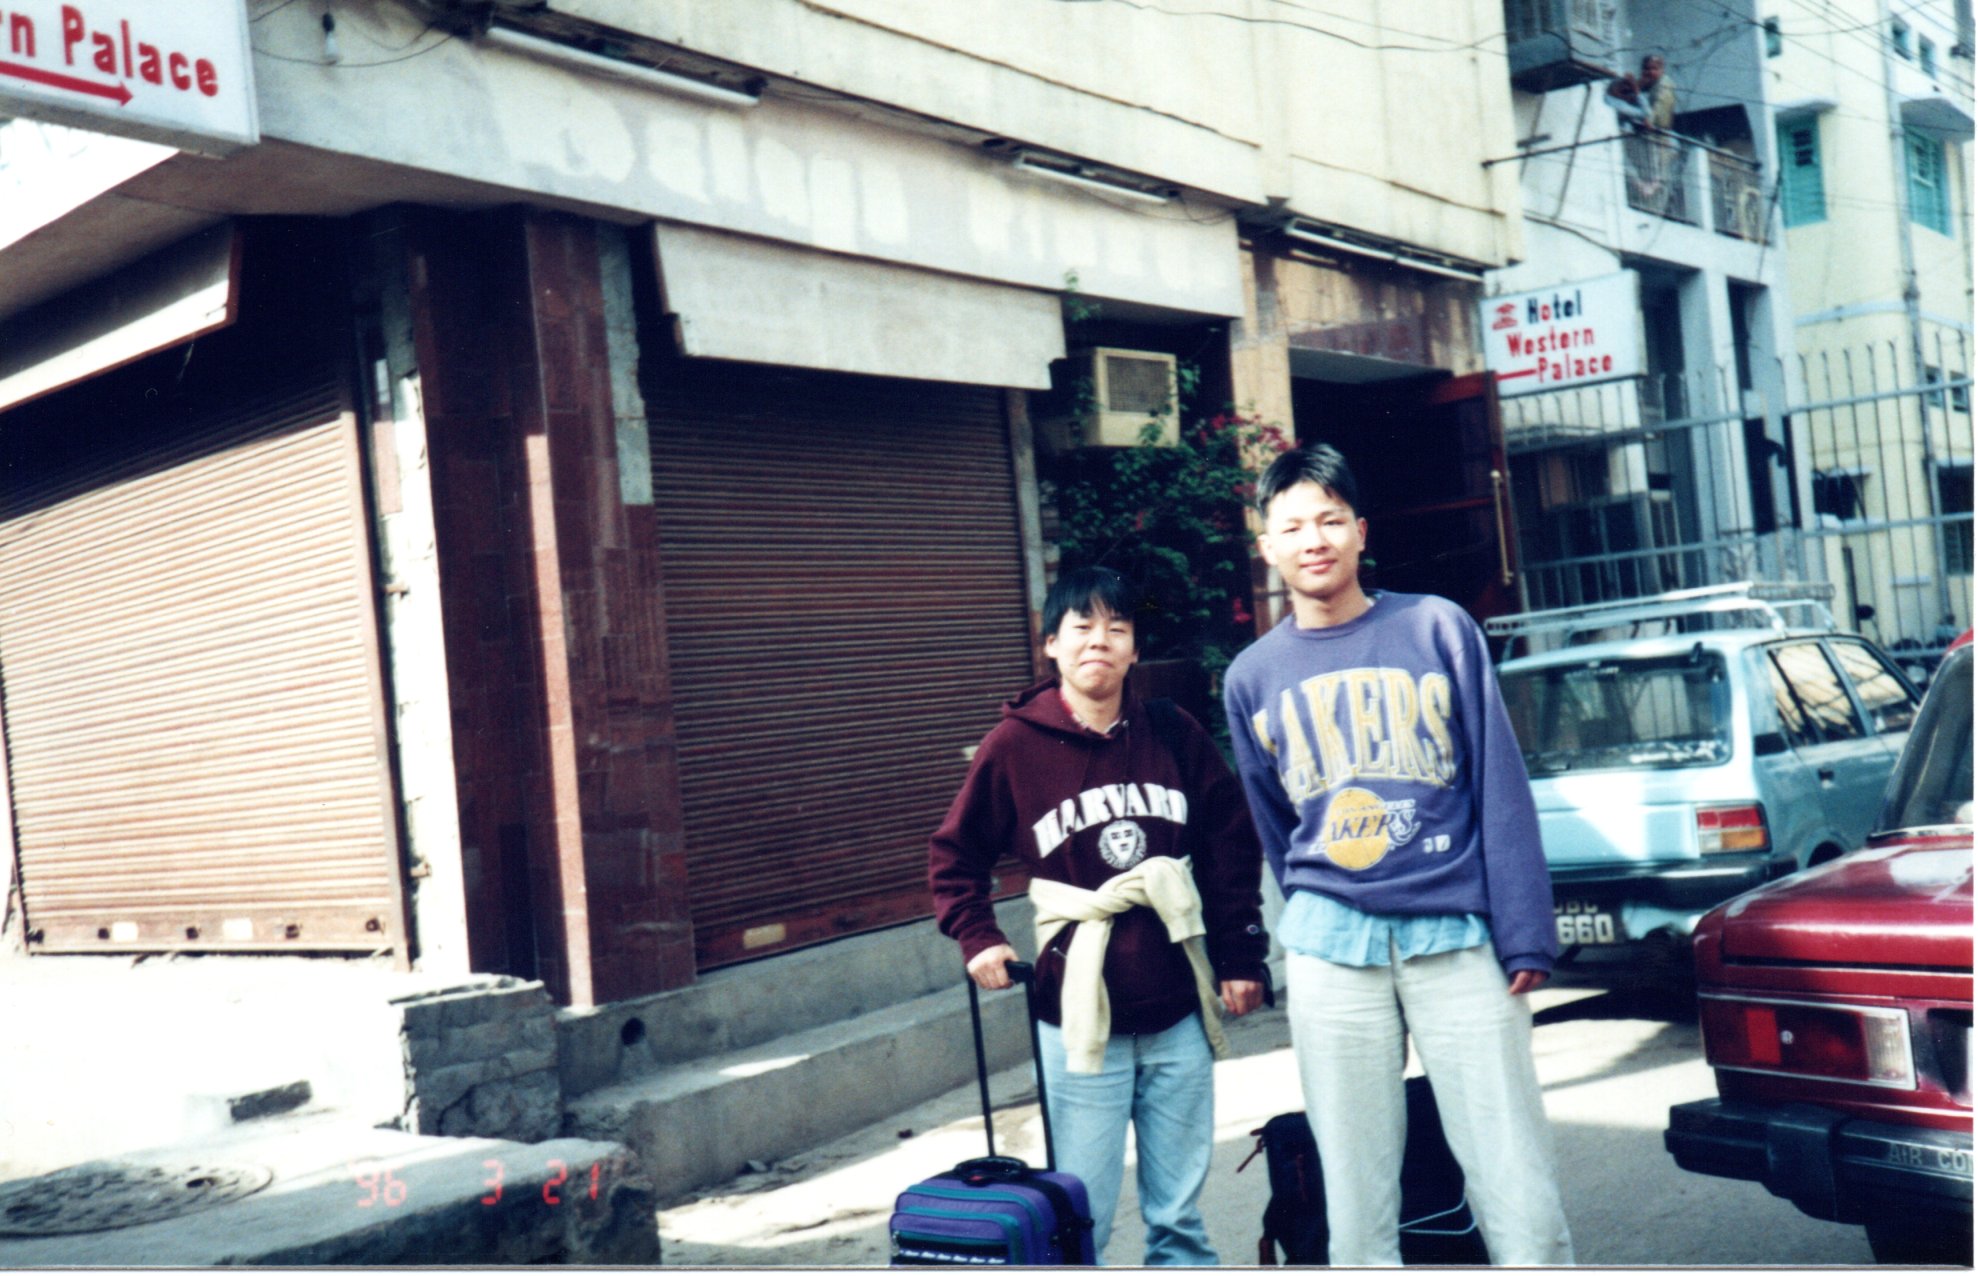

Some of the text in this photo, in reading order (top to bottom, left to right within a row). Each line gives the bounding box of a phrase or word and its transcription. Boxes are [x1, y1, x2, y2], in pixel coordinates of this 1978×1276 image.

[0, 4, 218, 97] n Palace
[1527, 289, 1582, 324] Hotel
[1506, 326, 1594, 357] Western
[1538, 353, 1612, 383] Palace
[1032, 782, 1188, 859] HARVARD
[1888, 1142, 1923, 1166] AIR
